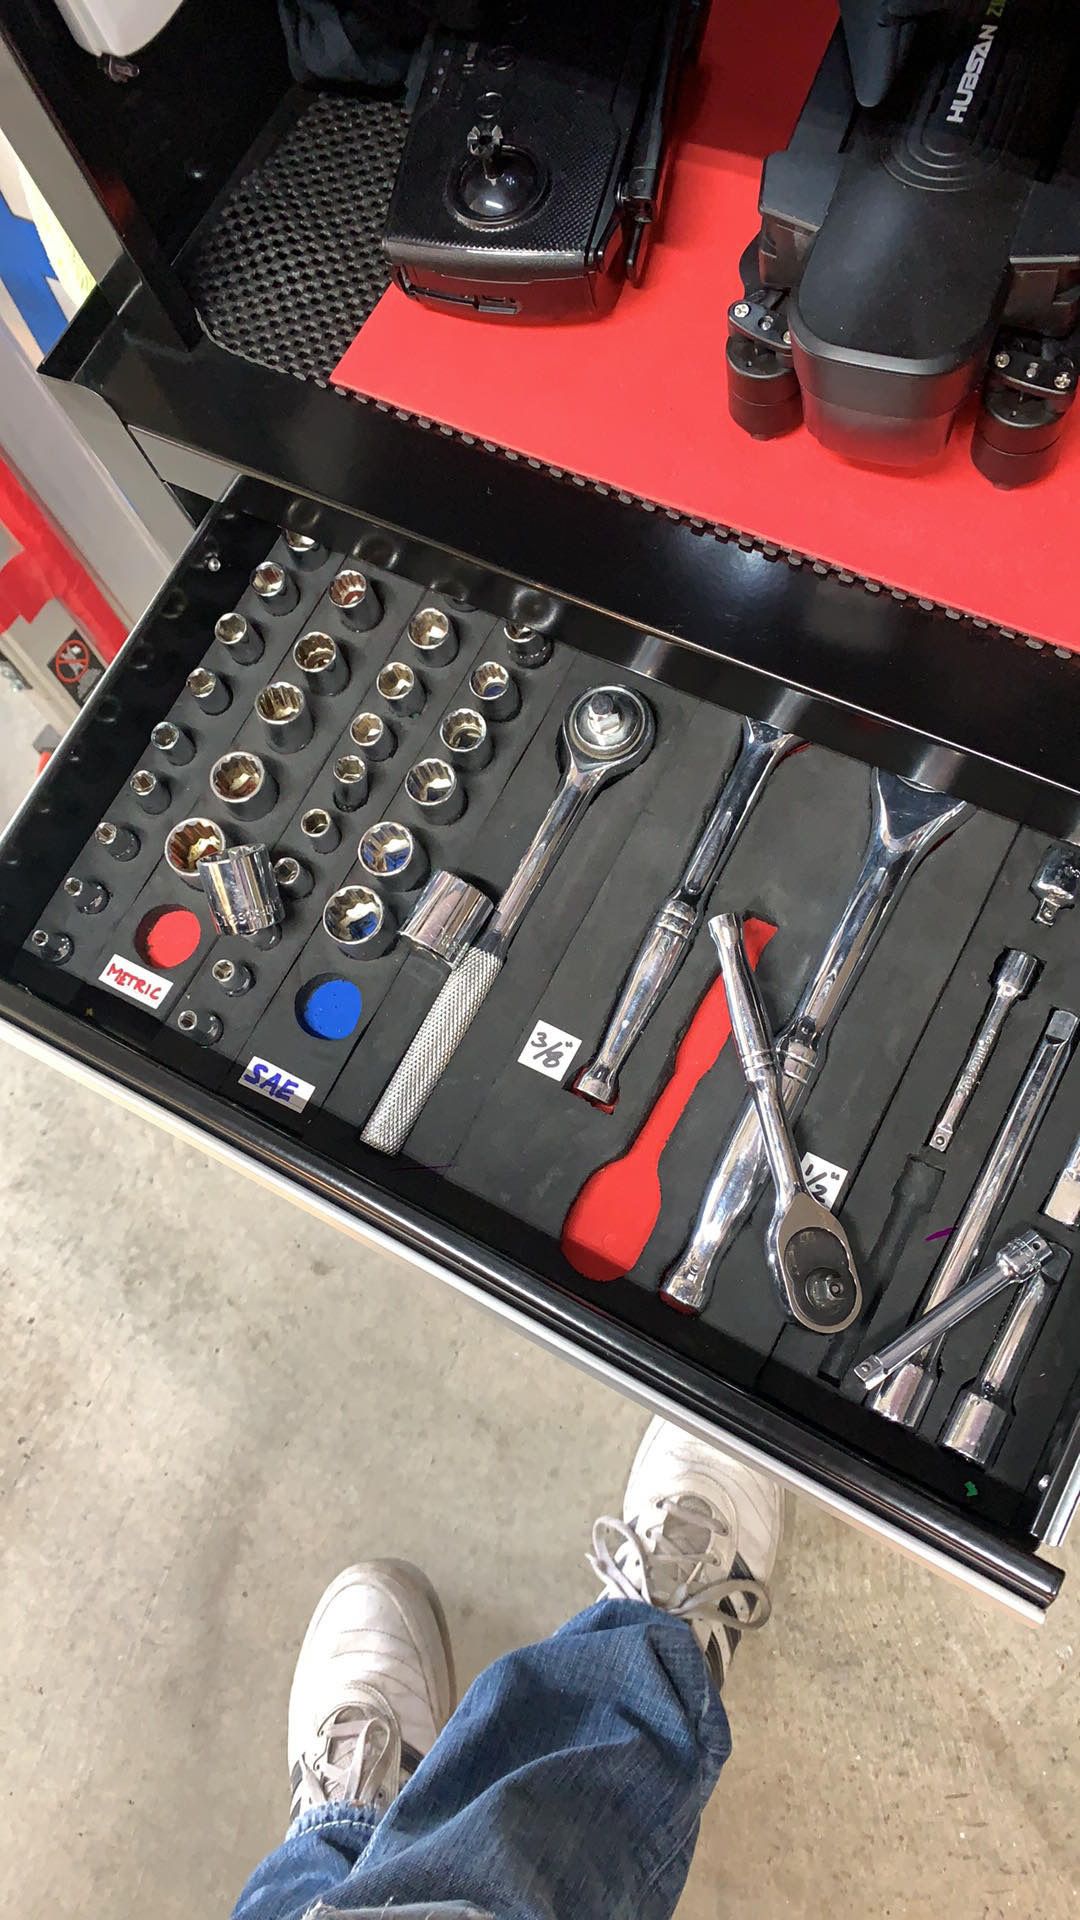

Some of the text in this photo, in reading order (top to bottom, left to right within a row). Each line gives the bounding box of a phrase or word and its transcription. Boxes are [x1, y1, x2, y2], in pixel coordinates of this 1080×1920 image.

[946, 24, 998, 123] HUBSAN
[106, 963, 162, 1000] METRIC
[243, 1063, 299, 1102] SAE
